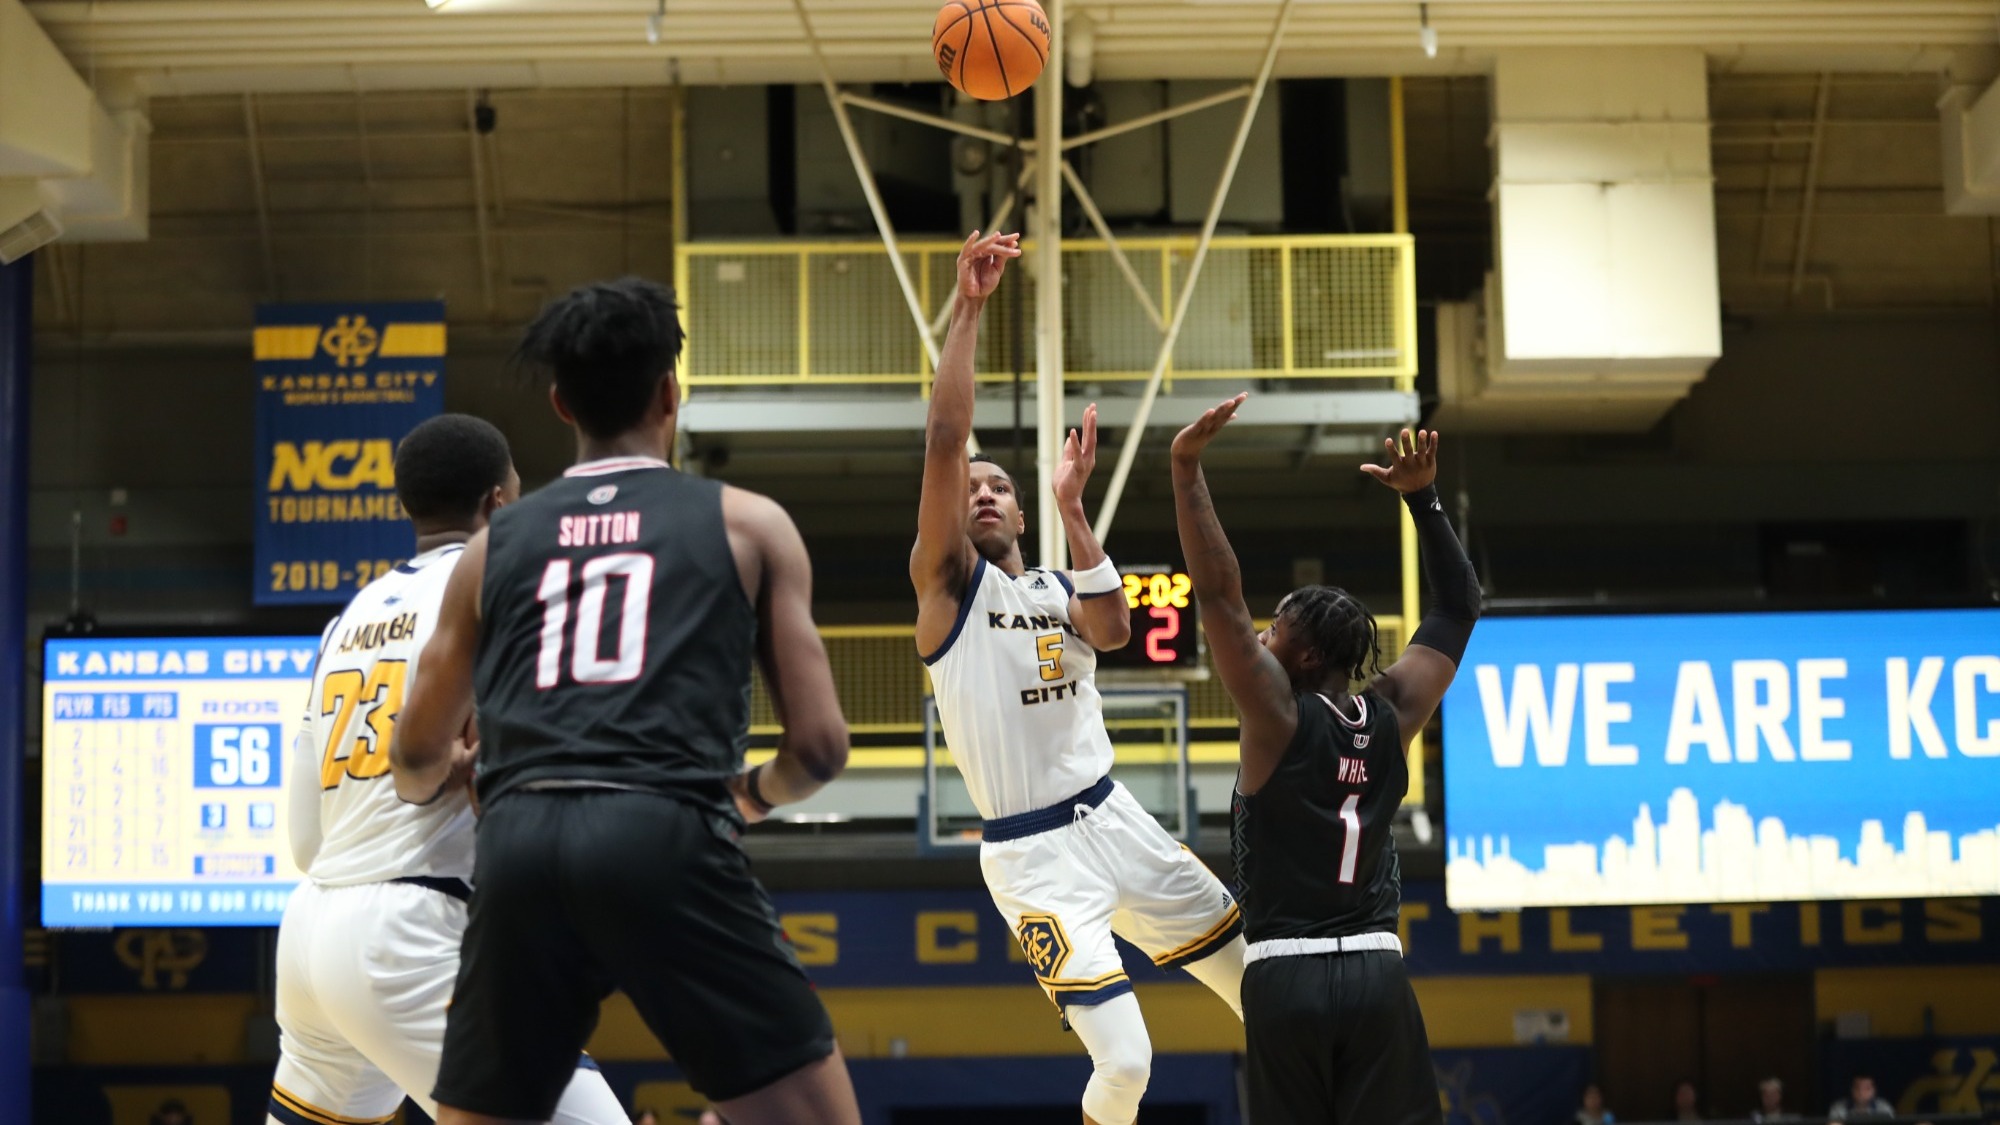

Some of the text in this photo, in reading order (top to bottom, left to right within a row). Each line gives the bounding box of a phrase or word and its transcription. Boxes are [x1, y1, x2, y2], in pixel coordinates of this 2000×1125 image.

[262, 370, 437, 391] KANSAS CITY
[268, 439, 395, 491] NCA
[269, 496, 411, 524] TOURNAME
[558, 511, 640, 547] SUTTON
[1122, 573, 1191, 608] 2:02
[536, 552, 655, 690] 10
[1146, 606, 1179, 661] 2
[57, 648, 315, 676] KANSAS CITY
[1036, 632, 1063, 682] 5
[103, 695, 130, 718] FLS
[143, 695, 173, 718] PTS
[202, 700, 279, 715] ROOS
[1021, 680, 1077, 706] CITY
[1475, 655, 2000, 768] WE ARE KC
[320, 658, 406, 791] 23
[210, 725, 271, 786] 56
[1338, 793, 1362, 885] 1
[72, 890, 130, 913] THANK
[137, 889, 173, 912] YOU
[179, 890, 202, 912] TO
[208, 889, 245, 912] OUR
[1397, 899, 1983, 956] THLETICS
